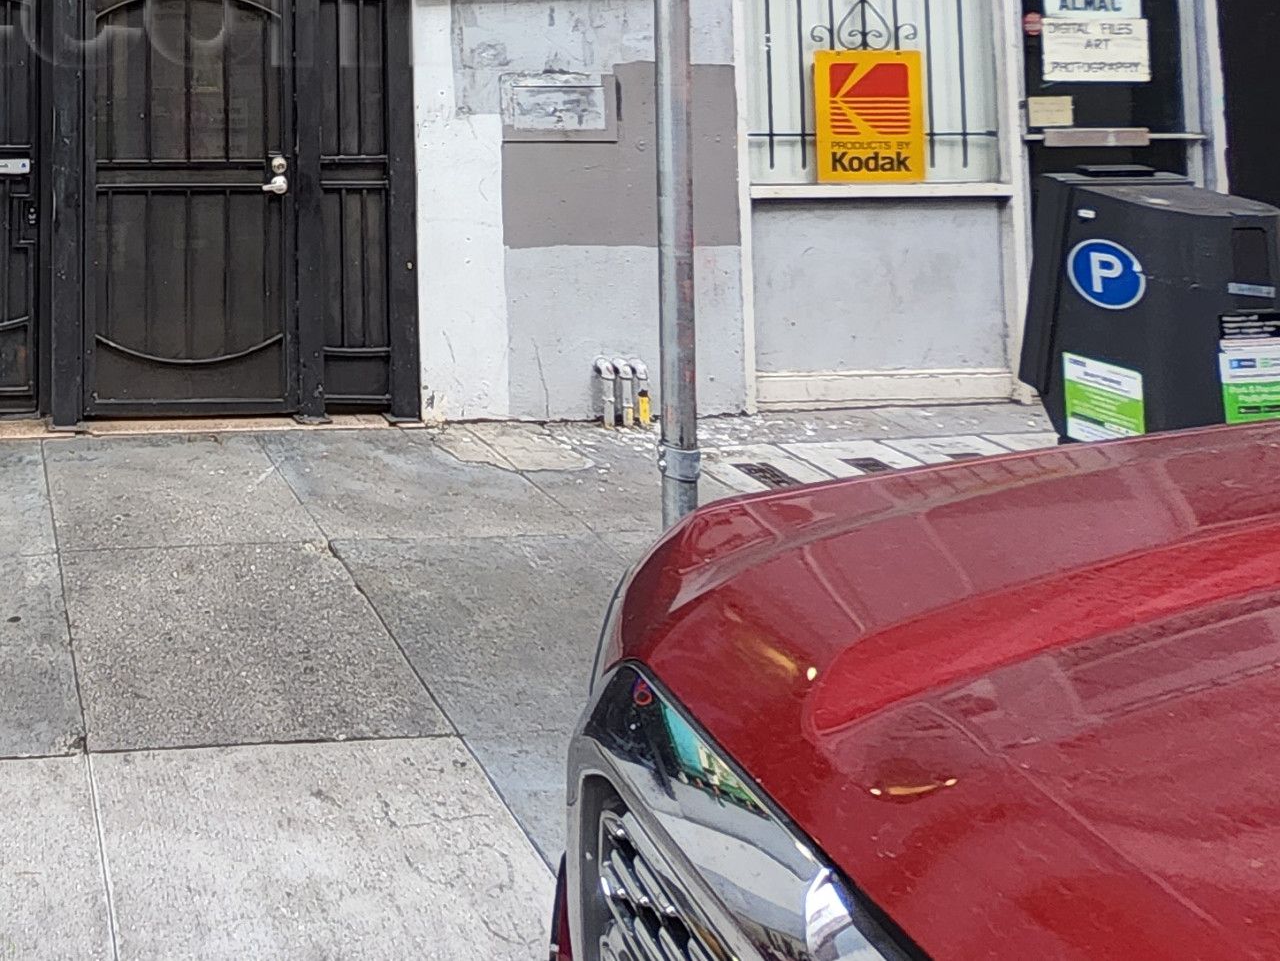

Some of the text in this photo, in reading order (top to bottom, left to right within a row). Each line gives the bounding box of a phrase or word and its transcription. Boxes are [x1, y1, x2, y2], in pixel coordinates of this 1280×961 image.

[1084, 38, 1111, 50] ART
[831, 141, 911, 150] PRODUCTS BY
[831, 151, 912, 172] Kodak
[1089, 251, 1123, 293] P
